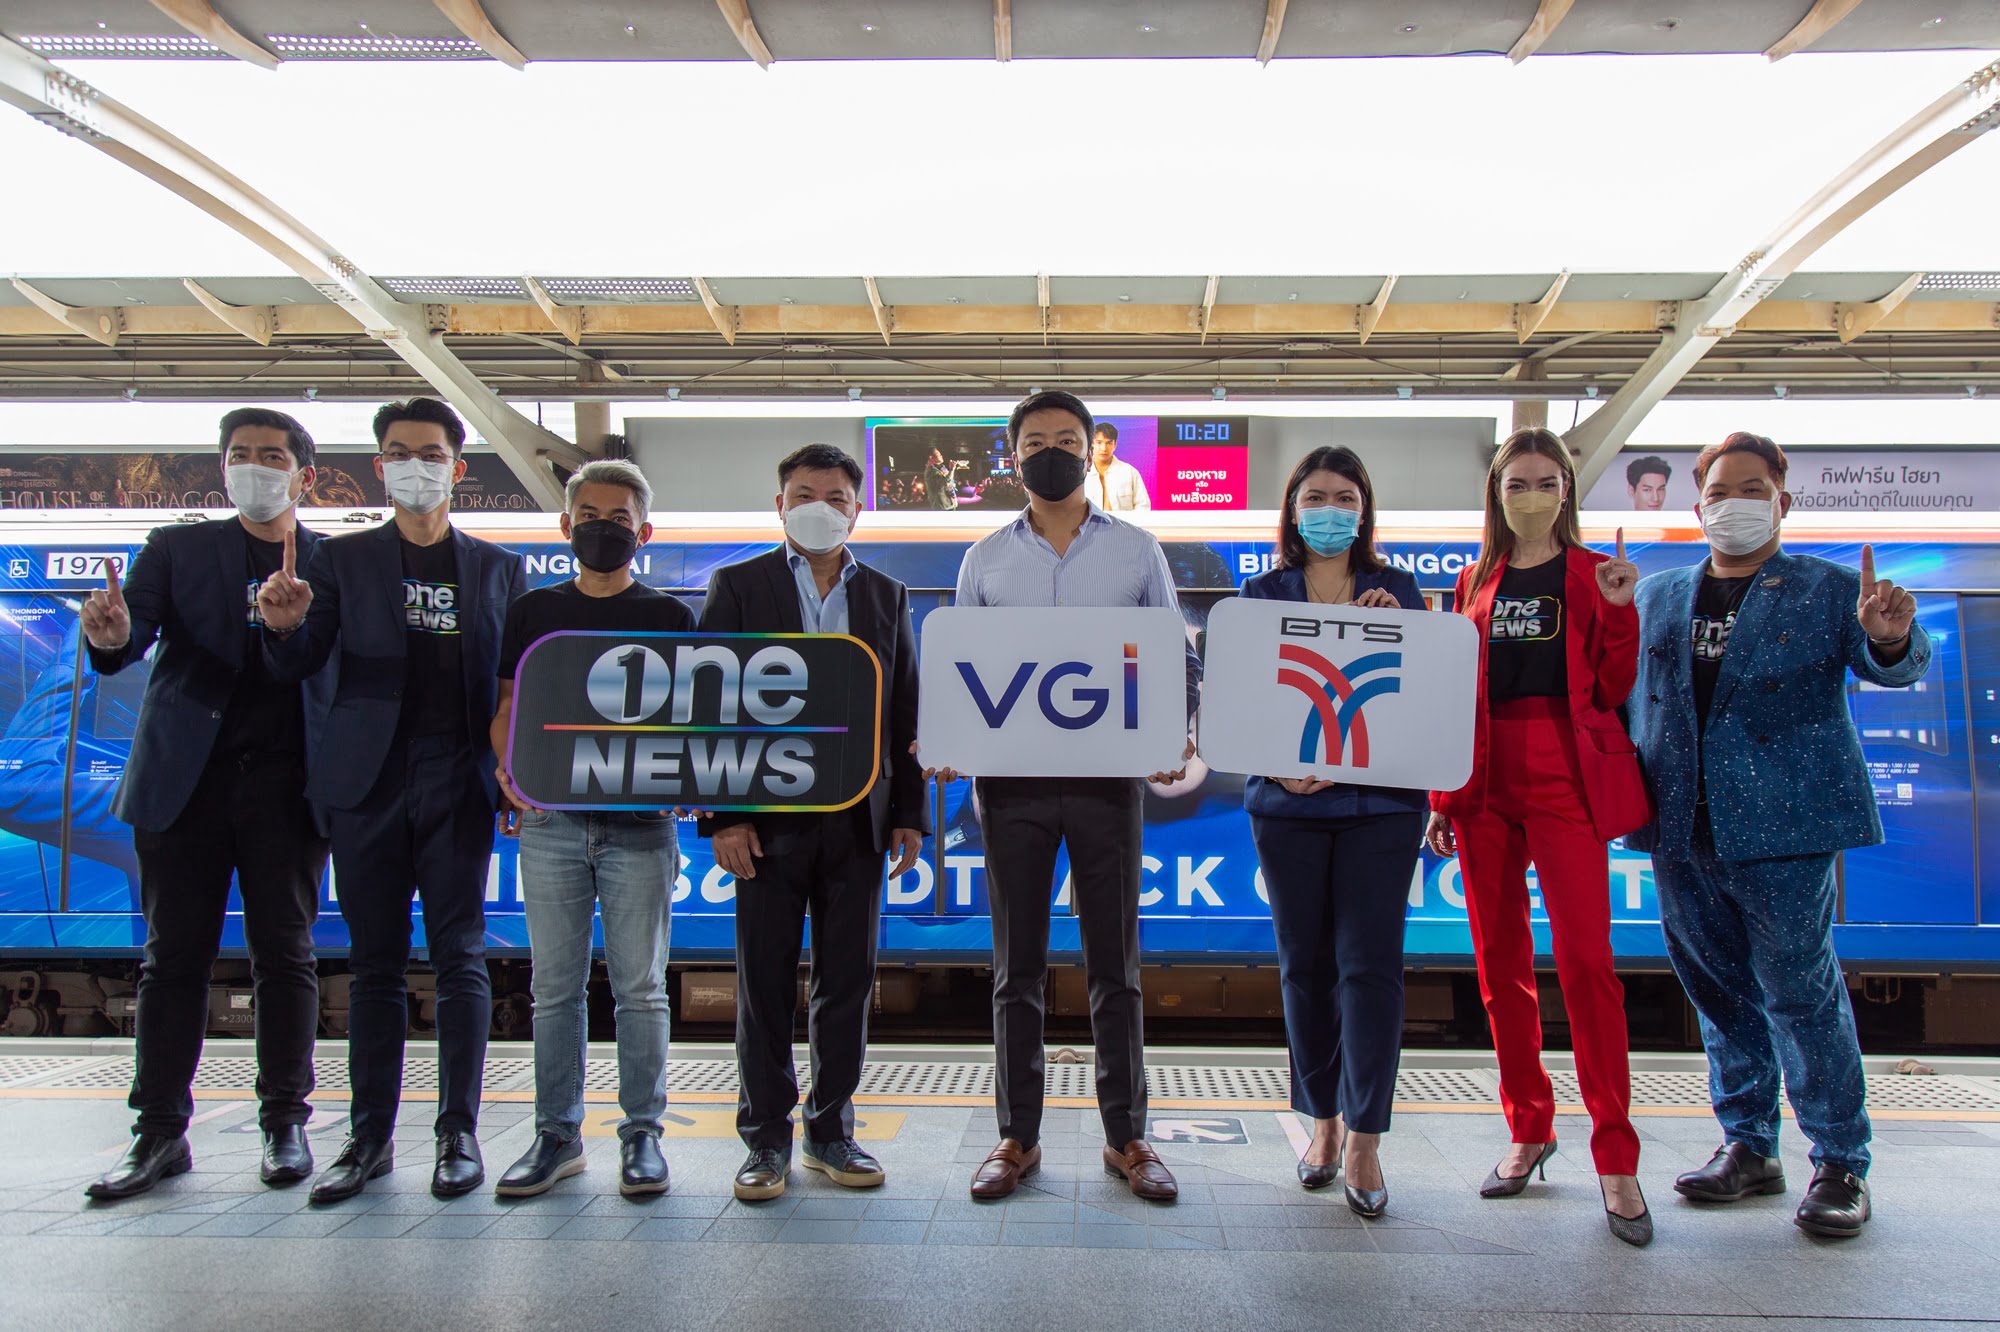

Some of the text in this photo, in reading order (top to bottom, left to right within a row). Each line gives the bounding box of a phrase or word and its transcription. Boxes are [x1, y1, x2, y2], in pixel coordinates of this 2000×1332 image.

[1176, 423, 1229, 440] 10:20
[1177, 470, 1227, 480] ของหาย
[1821, 466, 1940, 484] กิฟฟารีน ไฮยา
[0, 491, 81, 509] HOUSE
[127, 490, 234, 509] DRAGO
[460, 494, 536, 509] DRAGON
[1171, 487, 1233, 503] พบสิ่งของ
[1791, 486, 1973, 511] พื่อผิวหน้าดูดีในแบบคุณ
[406, 609, 457, 630] EWS
[1491, 618, 1541, 638] EWS
[1281, 616, 1403, 644] BTS
[570, 736, 816, 798] NEWS
[229, 1014, 253, 1024] 2300
